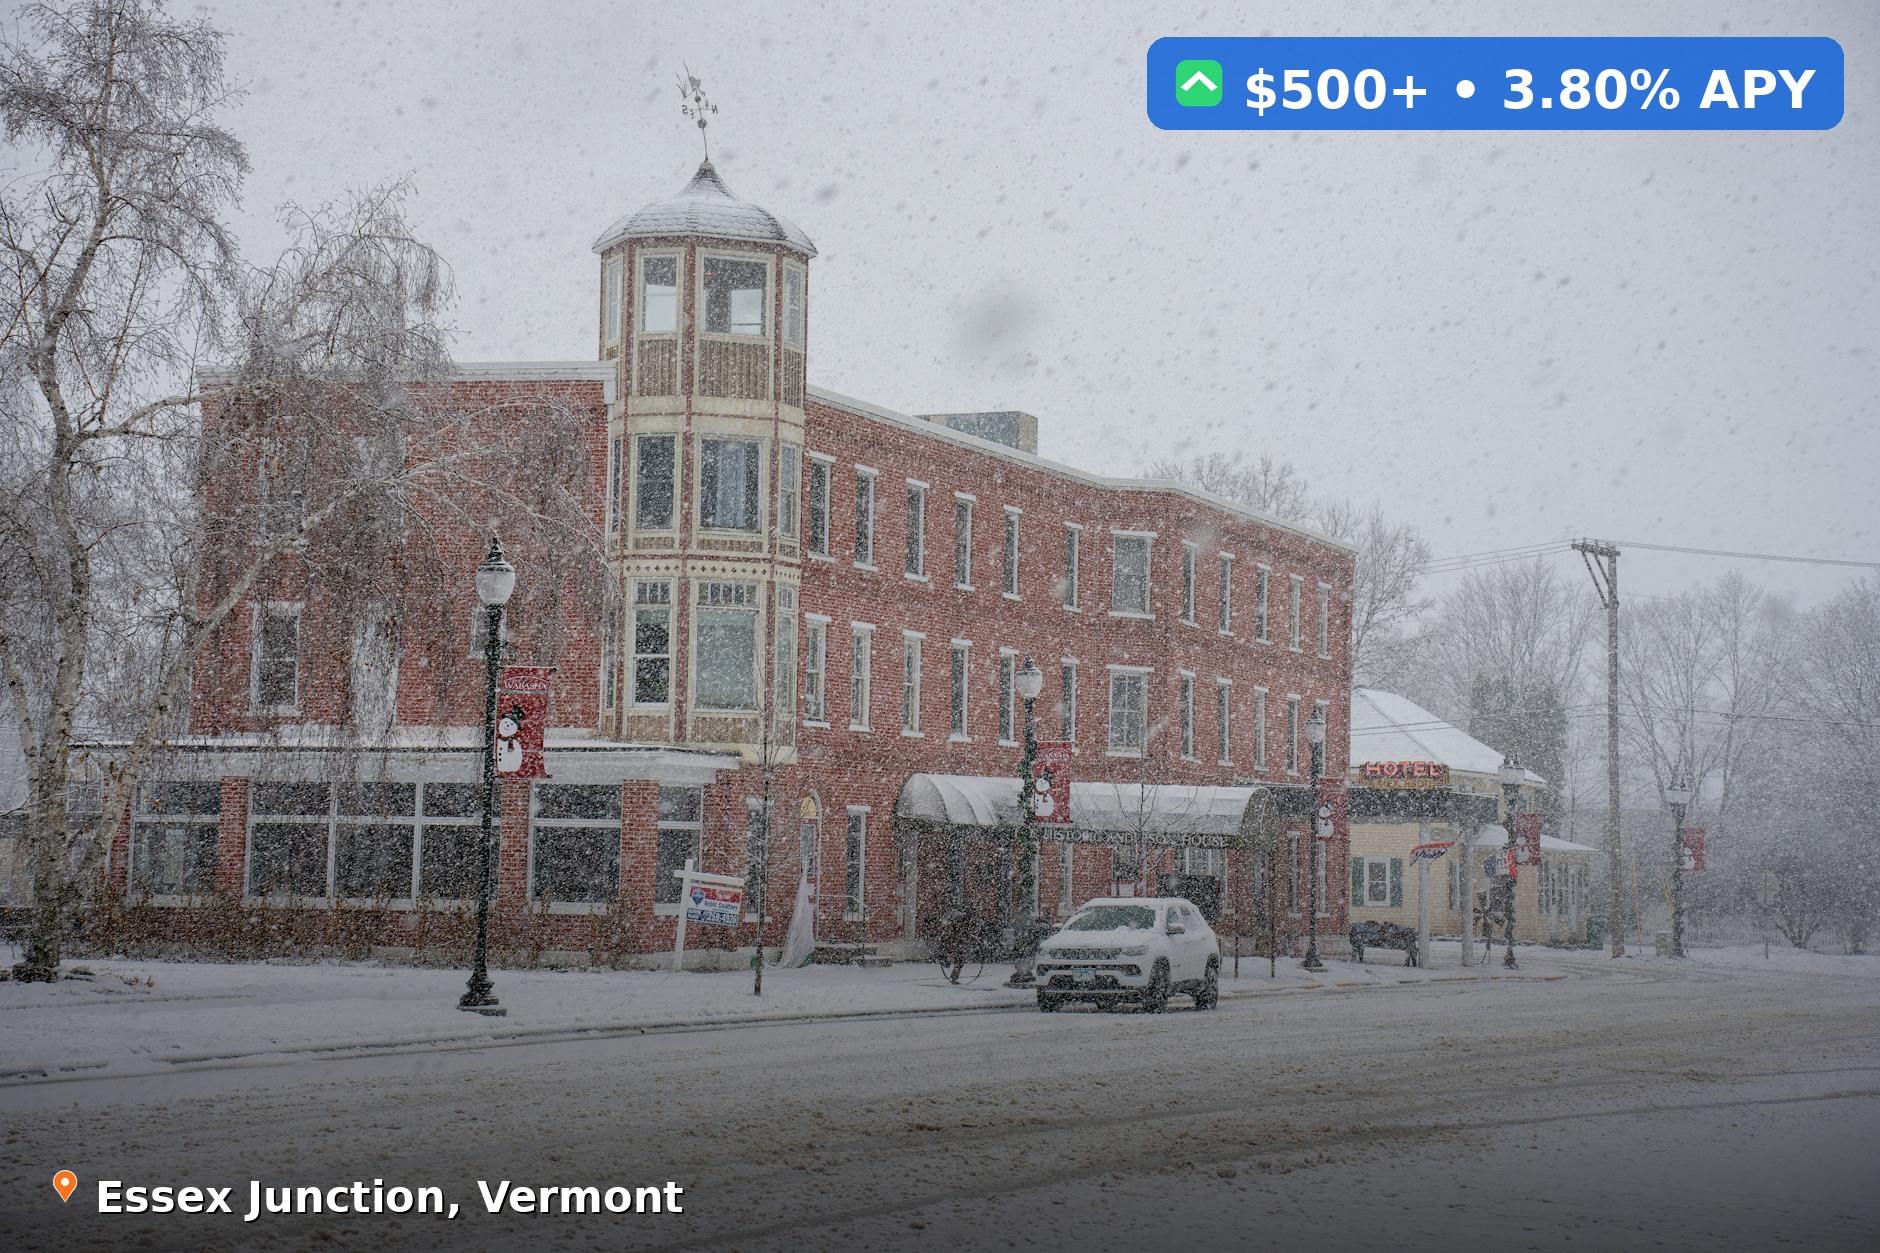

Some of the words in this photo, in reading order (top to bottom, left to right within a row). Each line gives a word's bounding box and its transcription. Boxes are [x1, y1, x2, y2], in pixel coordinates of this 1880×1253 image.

[504, 681, 548, 690] WABASHA
[1366, 761, 1440, 778] HOTEL
[1181, 833, 1230, 848] HOUSE
